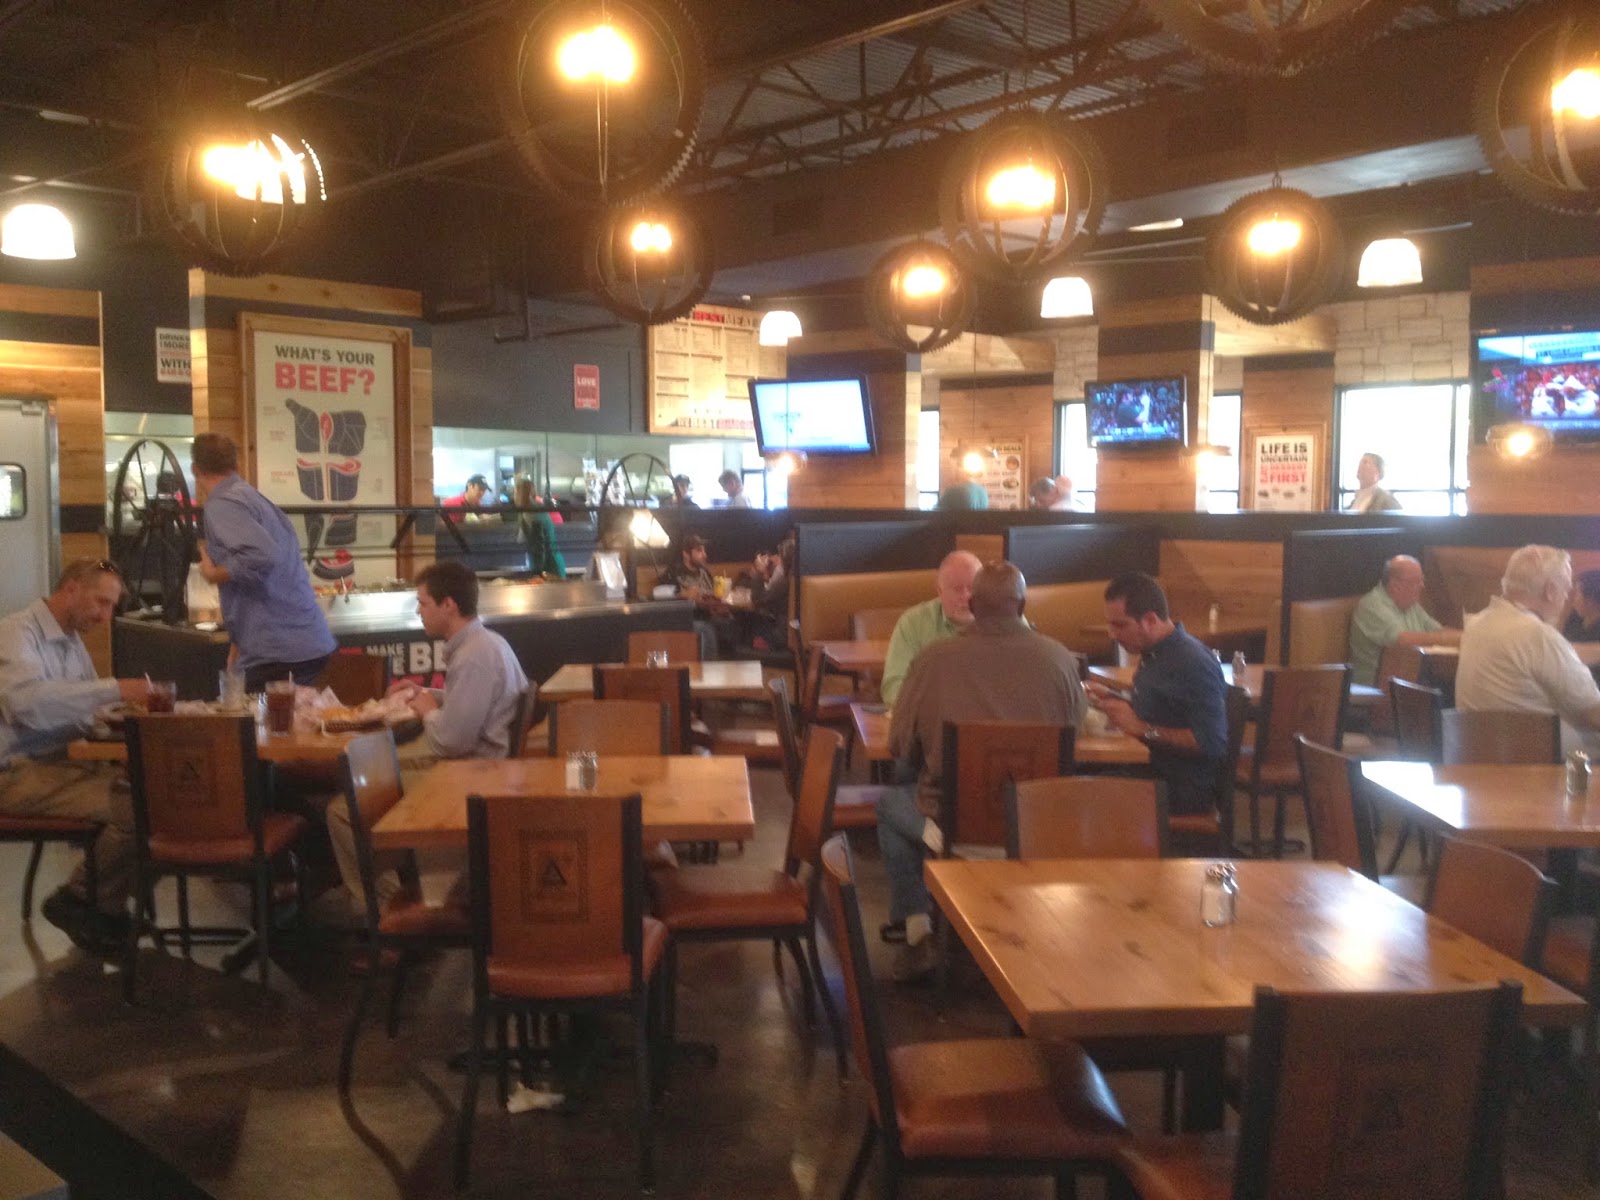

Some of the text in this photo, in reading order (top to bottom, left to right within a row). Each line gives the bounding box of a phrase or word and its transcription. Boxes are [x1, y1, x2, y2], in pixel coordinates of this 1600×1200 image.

[275, 345, 375, 364] WHAT'S YOUR
[275, 362, 375, 395] BEEF?
[577, 377, 596, 386] LOVE
[1261, 443, 1307, 454] LIFE IS
[1261, 454, 1308, 463] UNCERTAIN
[1270, 472, 1307, 483] FIRST
[366, 643, 405, 656] MAKE
